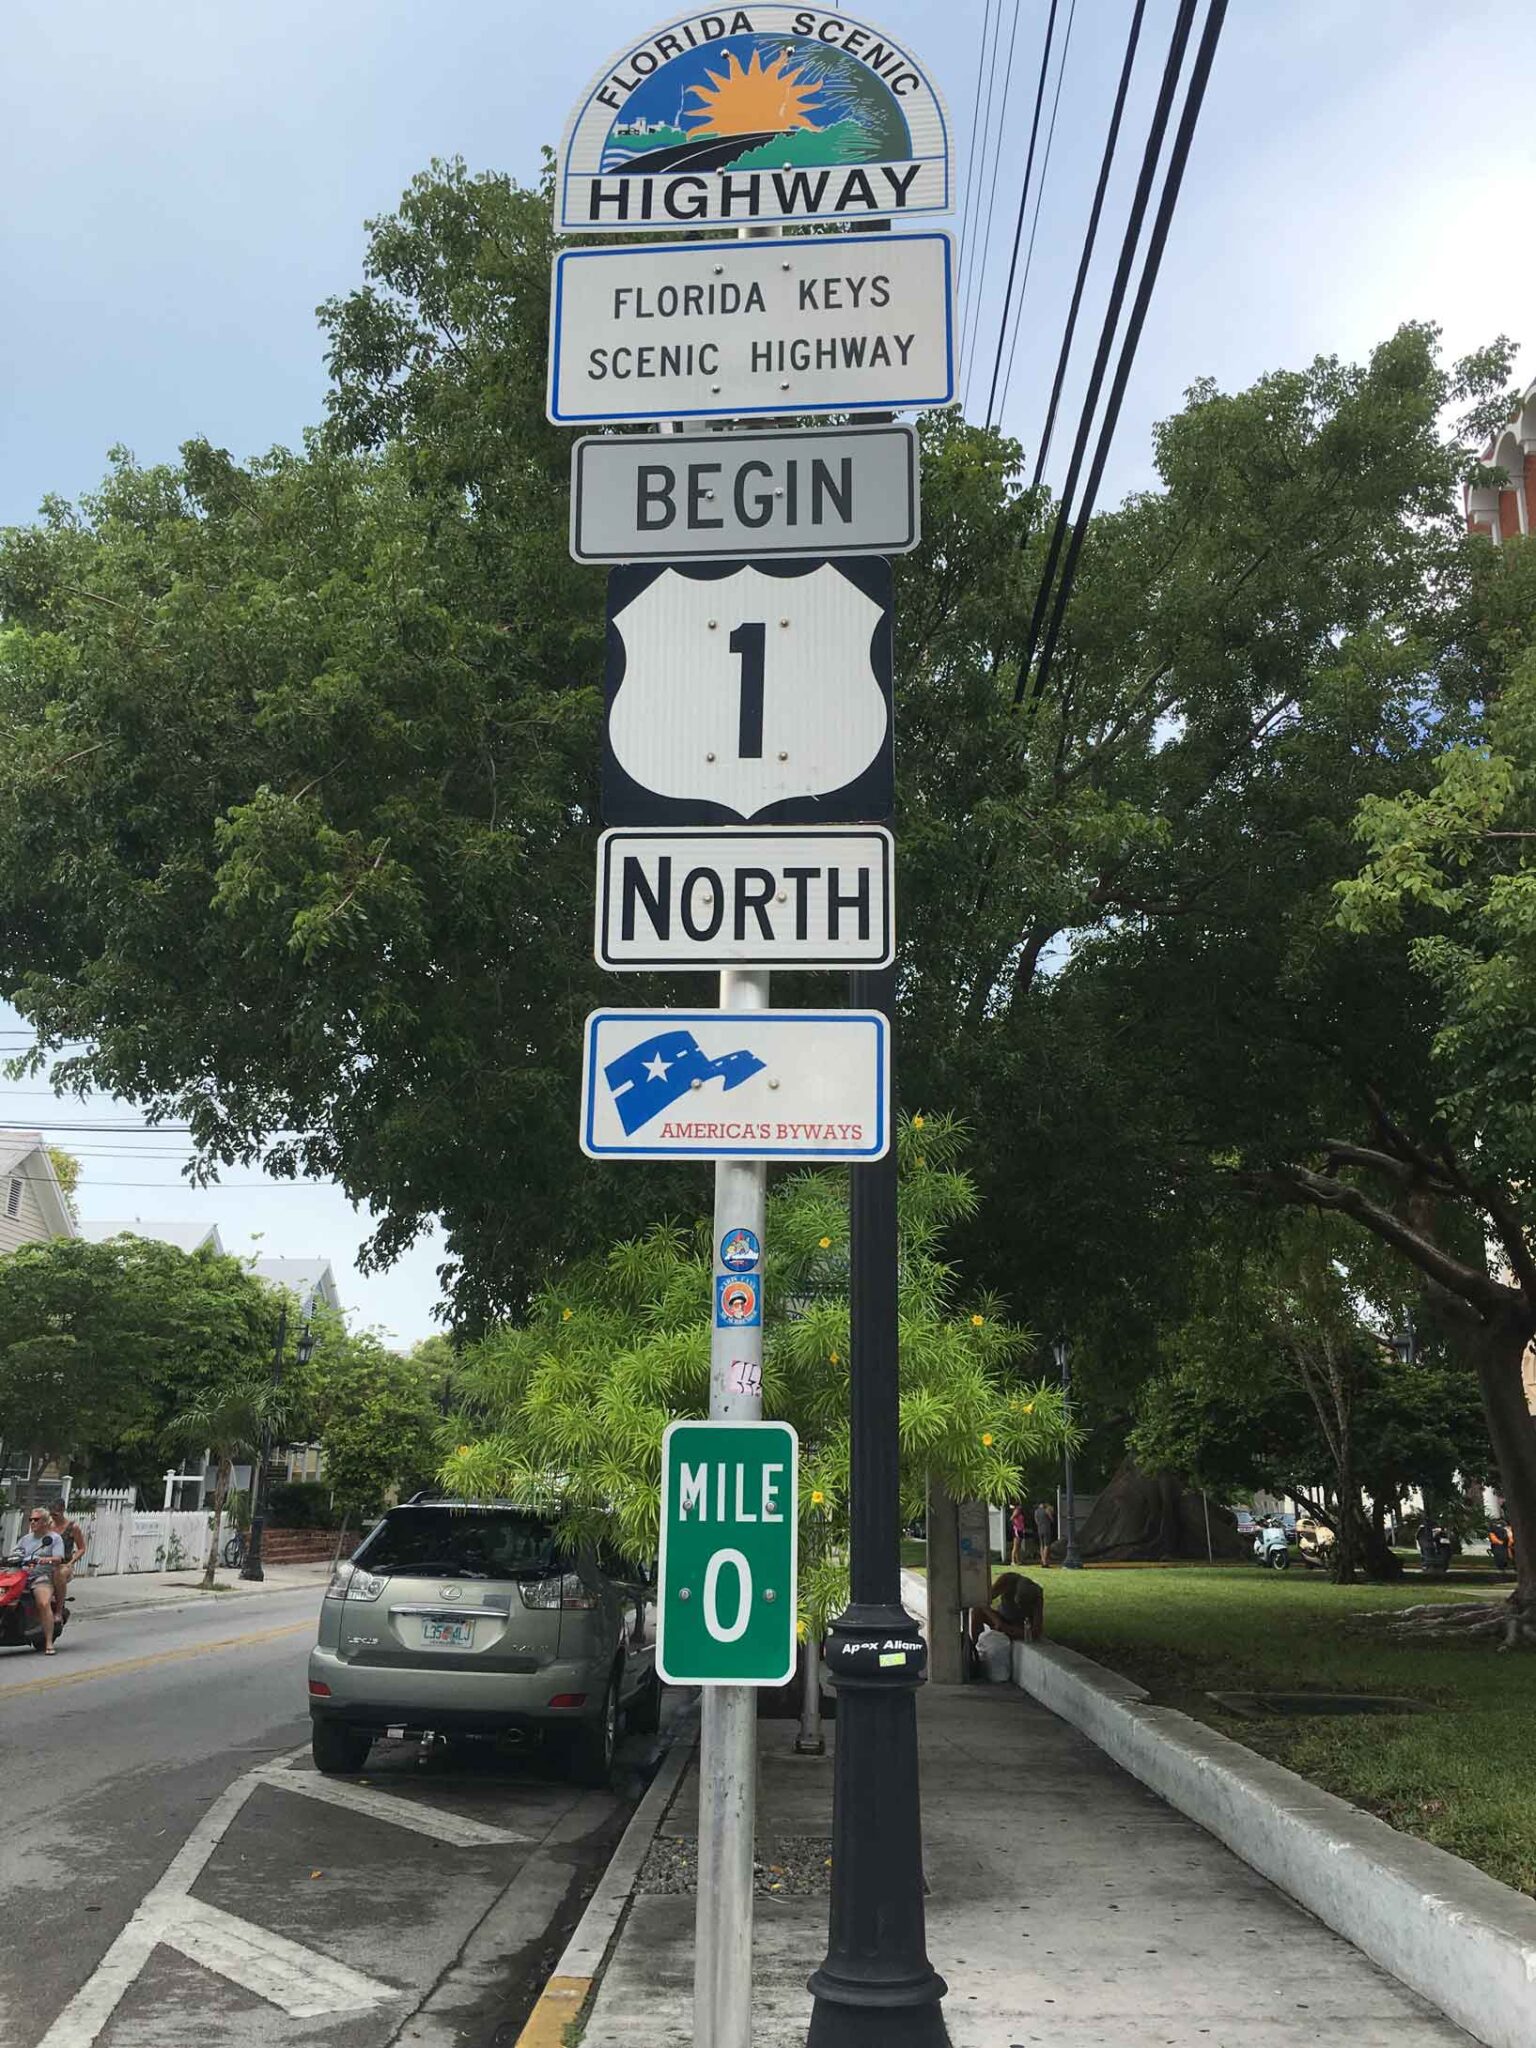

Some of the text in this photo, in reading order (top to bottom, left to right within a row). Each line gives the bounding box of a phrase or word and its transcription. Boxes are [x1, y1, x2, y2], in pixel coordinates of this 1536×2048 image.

[596, 11, 920, 110] FLORIDA SCENIC
[589, 163, 922, 221] HIGHWAY
[614, 275, 891, 319] FLORIDA KEYS
[588, 334, 915, 380] SCENIC HIGHWAY
[636, 457, 853, 531] BEGIN
[729, 622, 766, 759] 1
[621, 856, 870, 941] NORTH
[660, 1123, 863, 1140] AMERICA'S BYWAYS
[679, 1462, 784, 1523] MILE
[702, 1548, 753, 1643] 0
